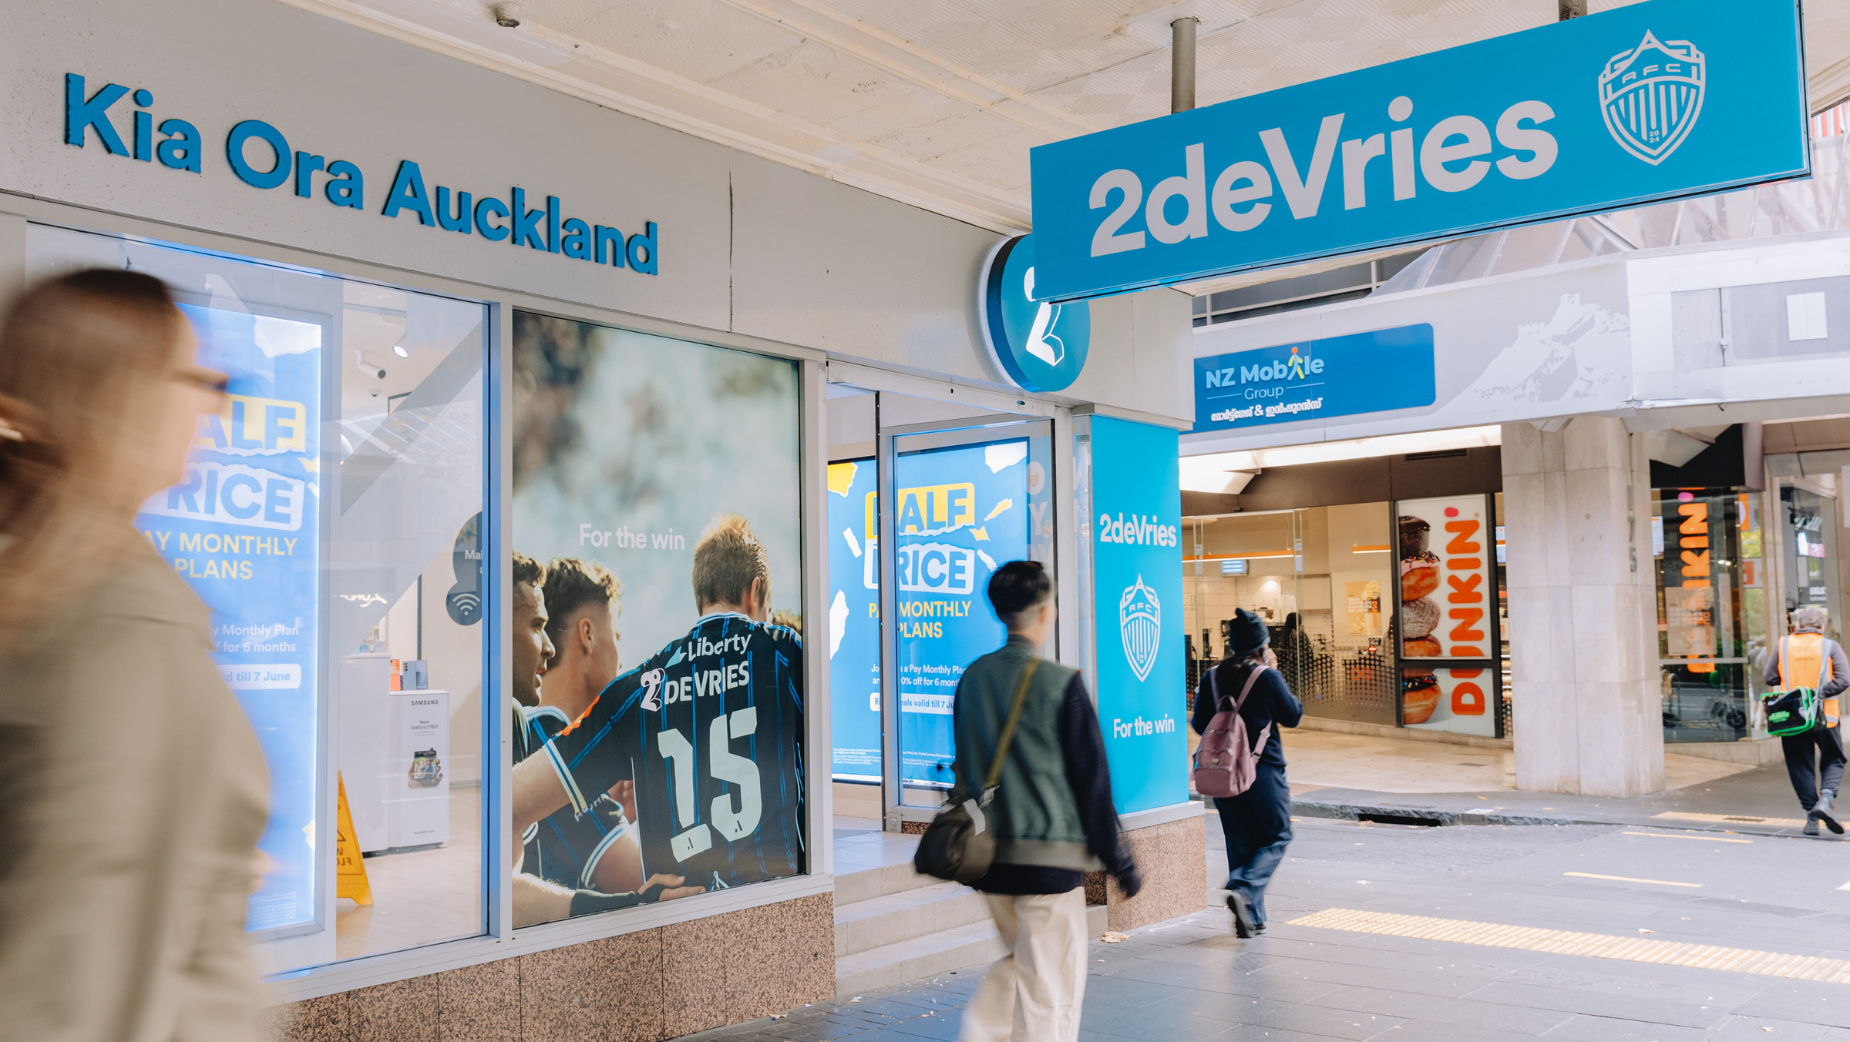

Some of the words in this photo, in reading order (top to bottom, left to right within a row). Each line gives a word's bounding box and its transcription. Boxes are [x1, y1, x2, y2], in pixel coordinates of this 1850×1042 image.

[1621, 63, 1681, 84] AFC
[64, 72, 202, 174] Kia
[226, 119, 364, 210] Ora
[381, 159, 658, 275] Auckland
[1089, 96, 1558, 257] 2deVries
[1205, 367, 1236, 389] NZ
[1244, 385, 1284, 400] Group
[1254, 404, 1264, 417] &
[191, 401, 296, 451] ALF
[167, 469, 293, 525] RICE
[580, 523, 611, 547] For
[616, 525, 647, 548] the
[651, 528, 685, 550] win
[1099, 512, 1177, 548] 2deVries
[180, 532, 298, 556] MONTHLY
[174, 558, 253, 580] PLANS
[900, 601, 971, 617] MONTHLY
[222, 624, 271, 638] Monthly
[275, 624, 299, 635] Plan
[223, 641, 240, 652] for
[243, 642, 250, 652] 6
[254, 641, 296, 652] months
[688, 633, 752, 662] Liberty
[236, 671, 251, 681] till
[254, 672, 261, 681] 7
[263, 671, 291, 681] June
[909, 665, 921, 674] Pay
[923, 665, 951, 676] Monthly
[913, 677, 922, 686] off
[923, 678, 933, 686] for
[934, 678, 939, 686] 6
[914, 699, 930, 708] valid
[931, 700, 940, 708] till
[1113, 718, 1133, 739] For
[1134, 716, 1153, 736] the
[1154, 713, 1175, 734] win
[657, 706, 762, 863] 15
